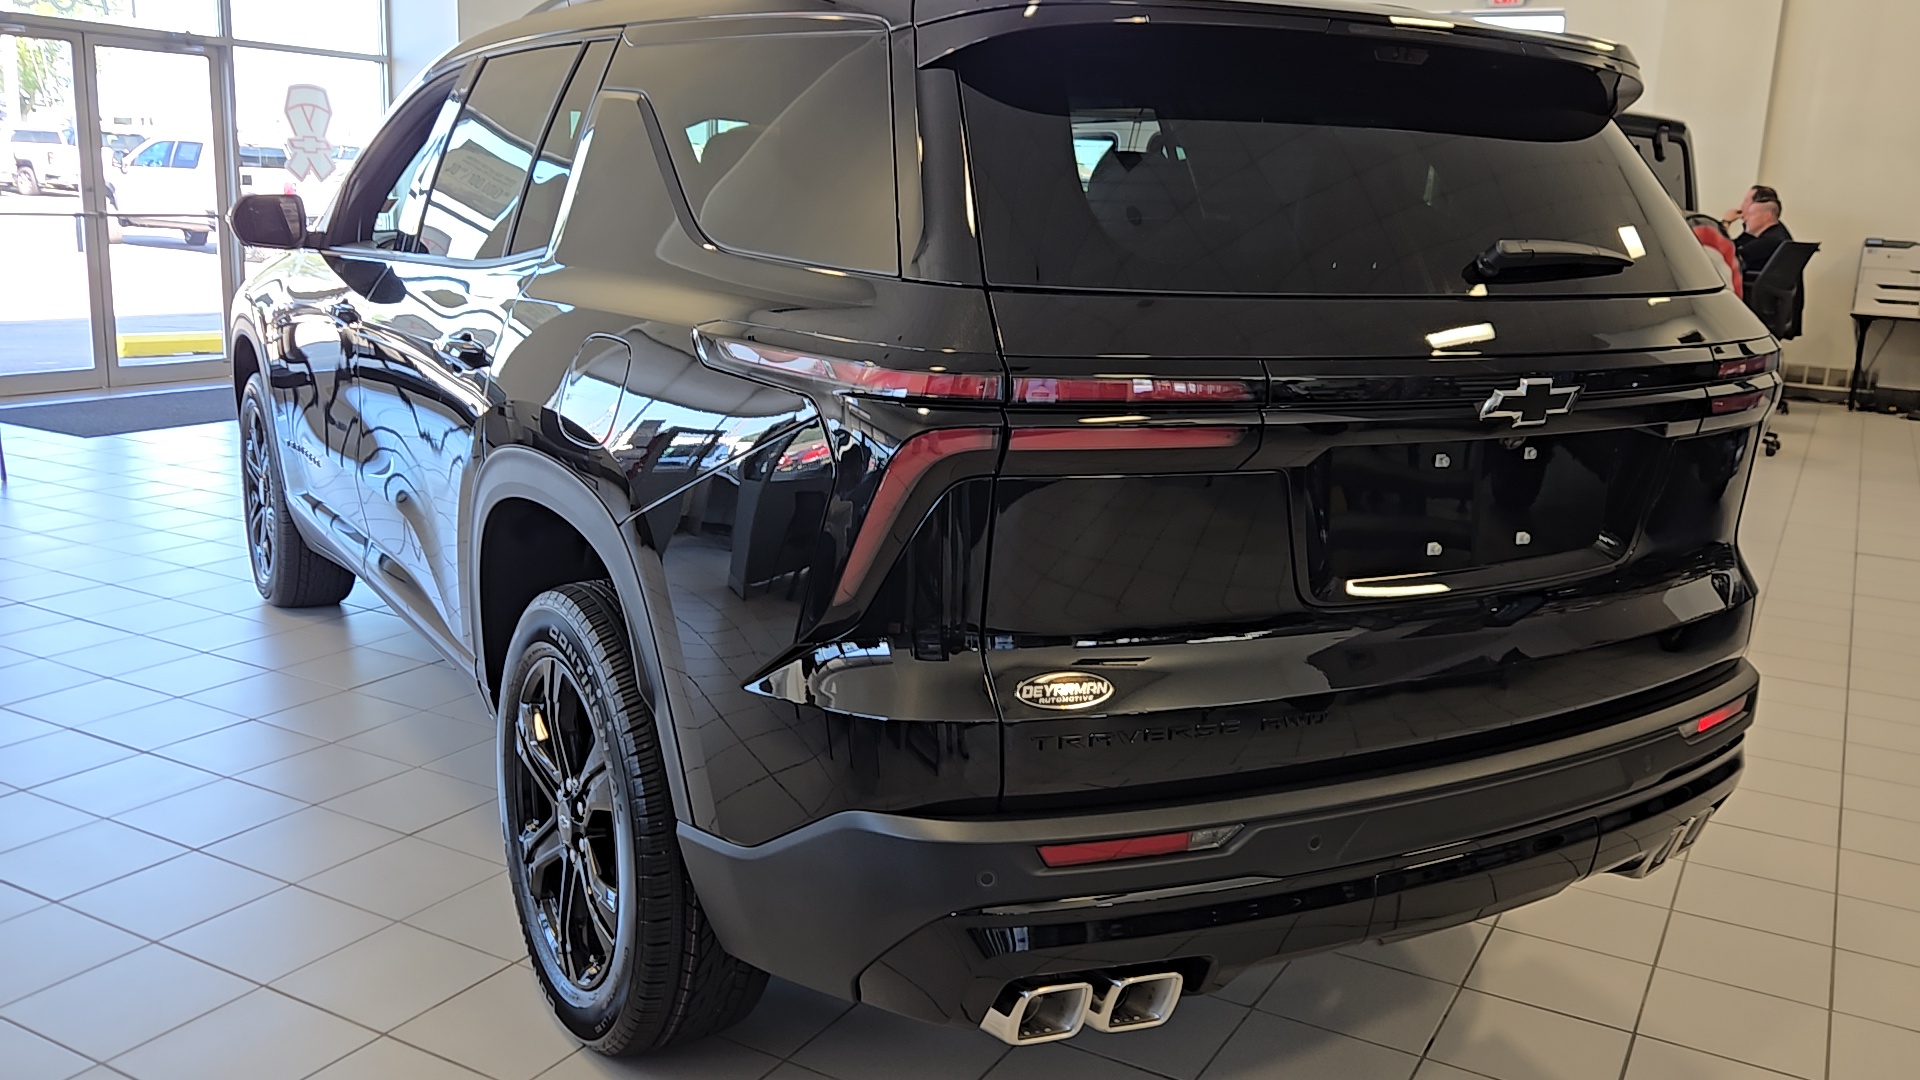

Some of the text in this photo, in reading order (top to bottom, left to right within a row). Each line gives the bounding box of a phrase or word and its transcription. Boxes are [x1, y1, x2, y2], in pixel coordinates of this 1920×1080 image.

[1038, 694, 1094, 704] AUTOMOTIVE
[1030, 710, 1328, 751] TRAVERSE AWD
